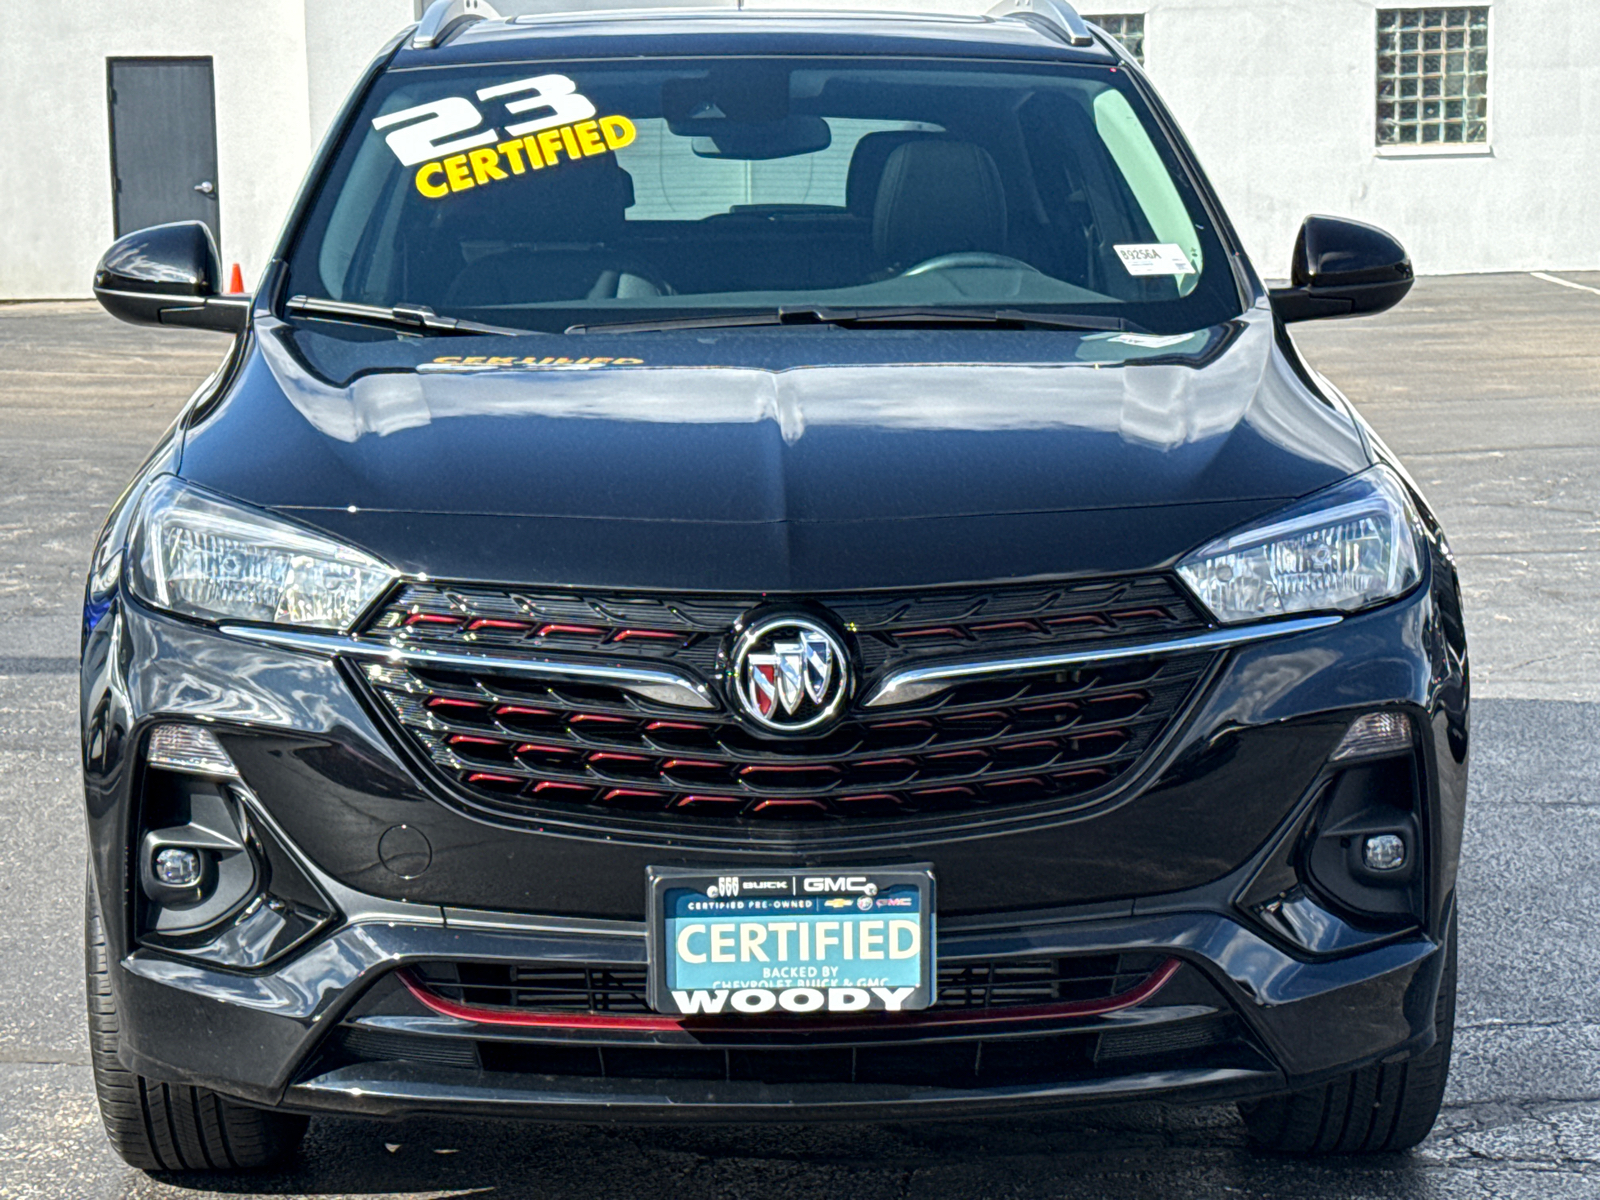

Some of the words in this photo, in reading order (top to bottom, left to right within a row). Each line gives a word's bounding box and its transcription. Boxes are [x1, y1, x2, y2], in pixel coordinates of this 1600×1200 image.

[371, 74, 597, 167] 23
[415, 115, 637, 198] CERTIFIED
[742, 880, 788, 890] BUICK
[804, 877, 866, 892] GMC
[688, 901, 744, 911] CERTIFIED
[748, 899, 813, 909] PRE-OWNED
[876, 898, 912, 907] GMC
[677, 919, 921, 963] CERTIFIED
[763, 966, 817, 979] BACKED
[822, 966, 839, 978] BY
[672, 987, 915, 1014] WOODY
